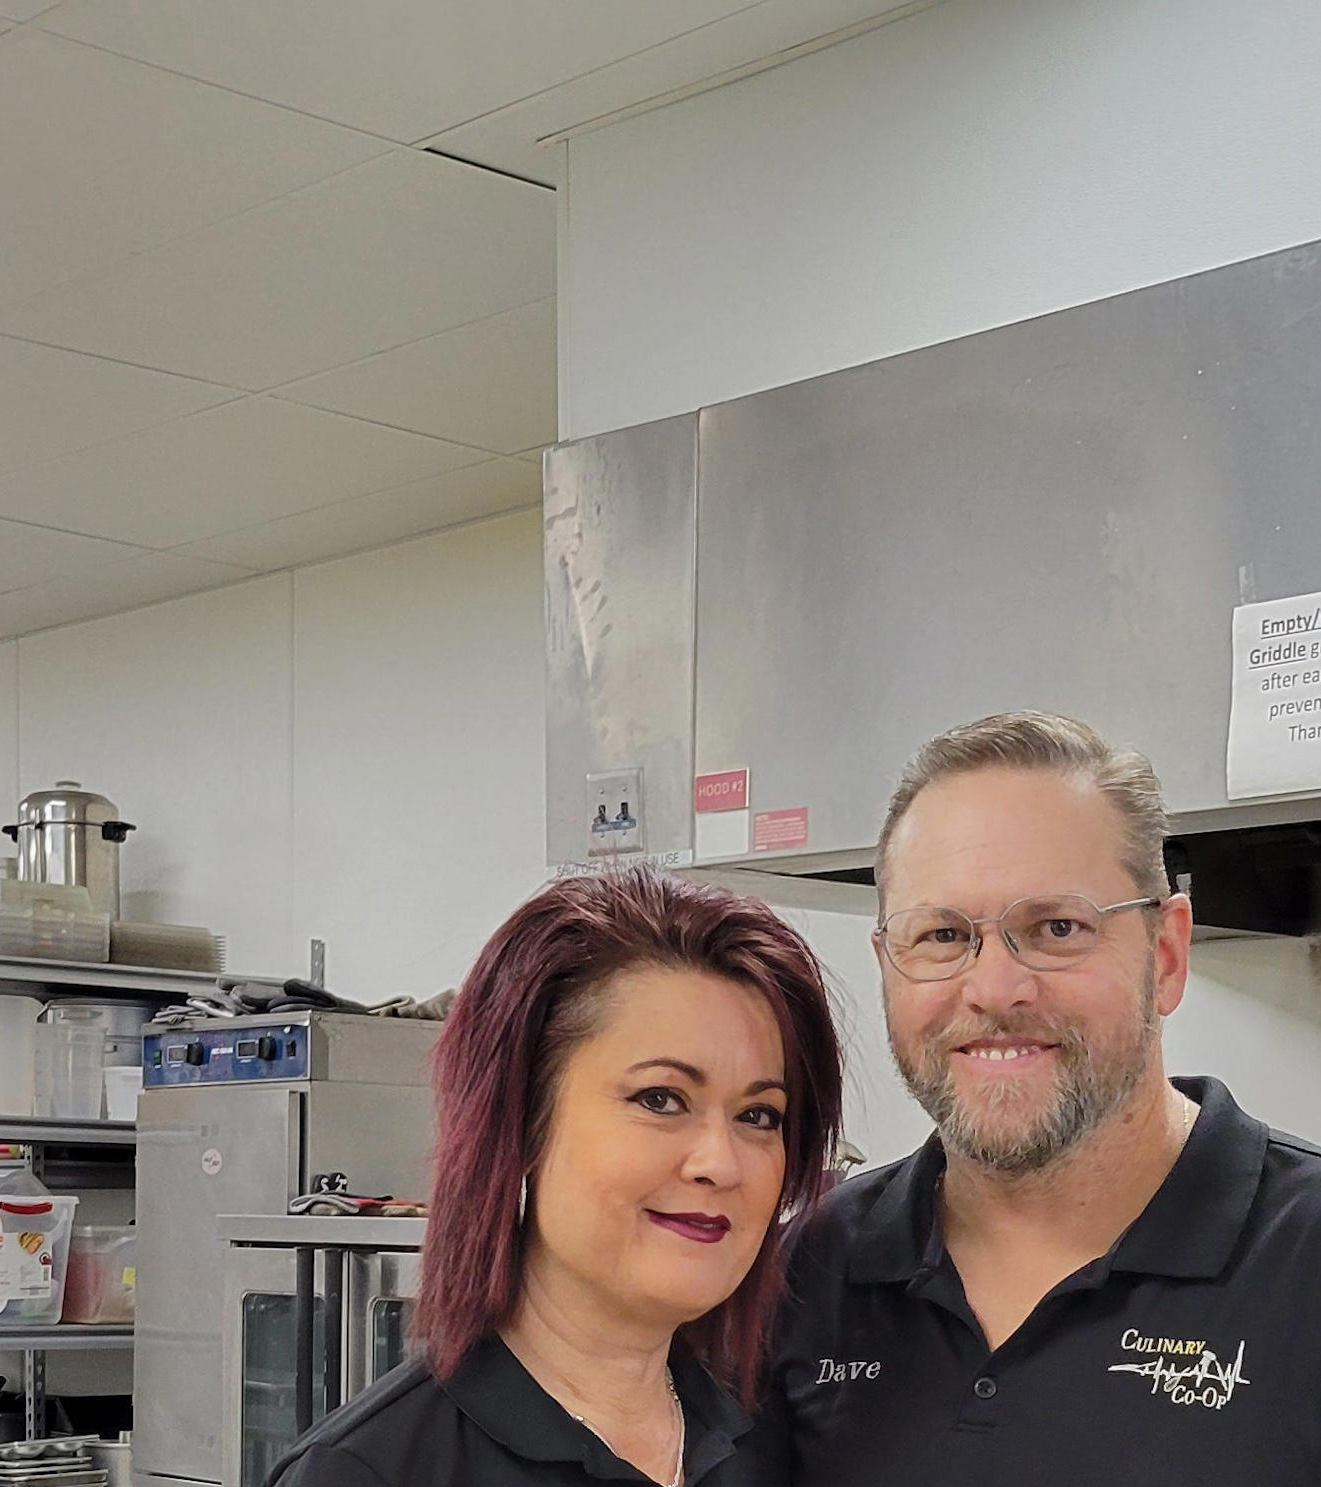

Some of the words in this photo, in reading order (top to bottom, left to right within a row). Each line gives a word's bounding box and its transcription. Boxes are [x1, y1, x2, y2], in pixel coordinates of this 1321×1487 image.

[1249, 642, 1307, 666] Griddle
[1261, 671, 1298, 692] after
[698, 781, 730, 798] HOOD
[732, 779, 744, 793] #2
[661, 852, 679, 866] USE
[814, 1358, 881, 1385] Dave
